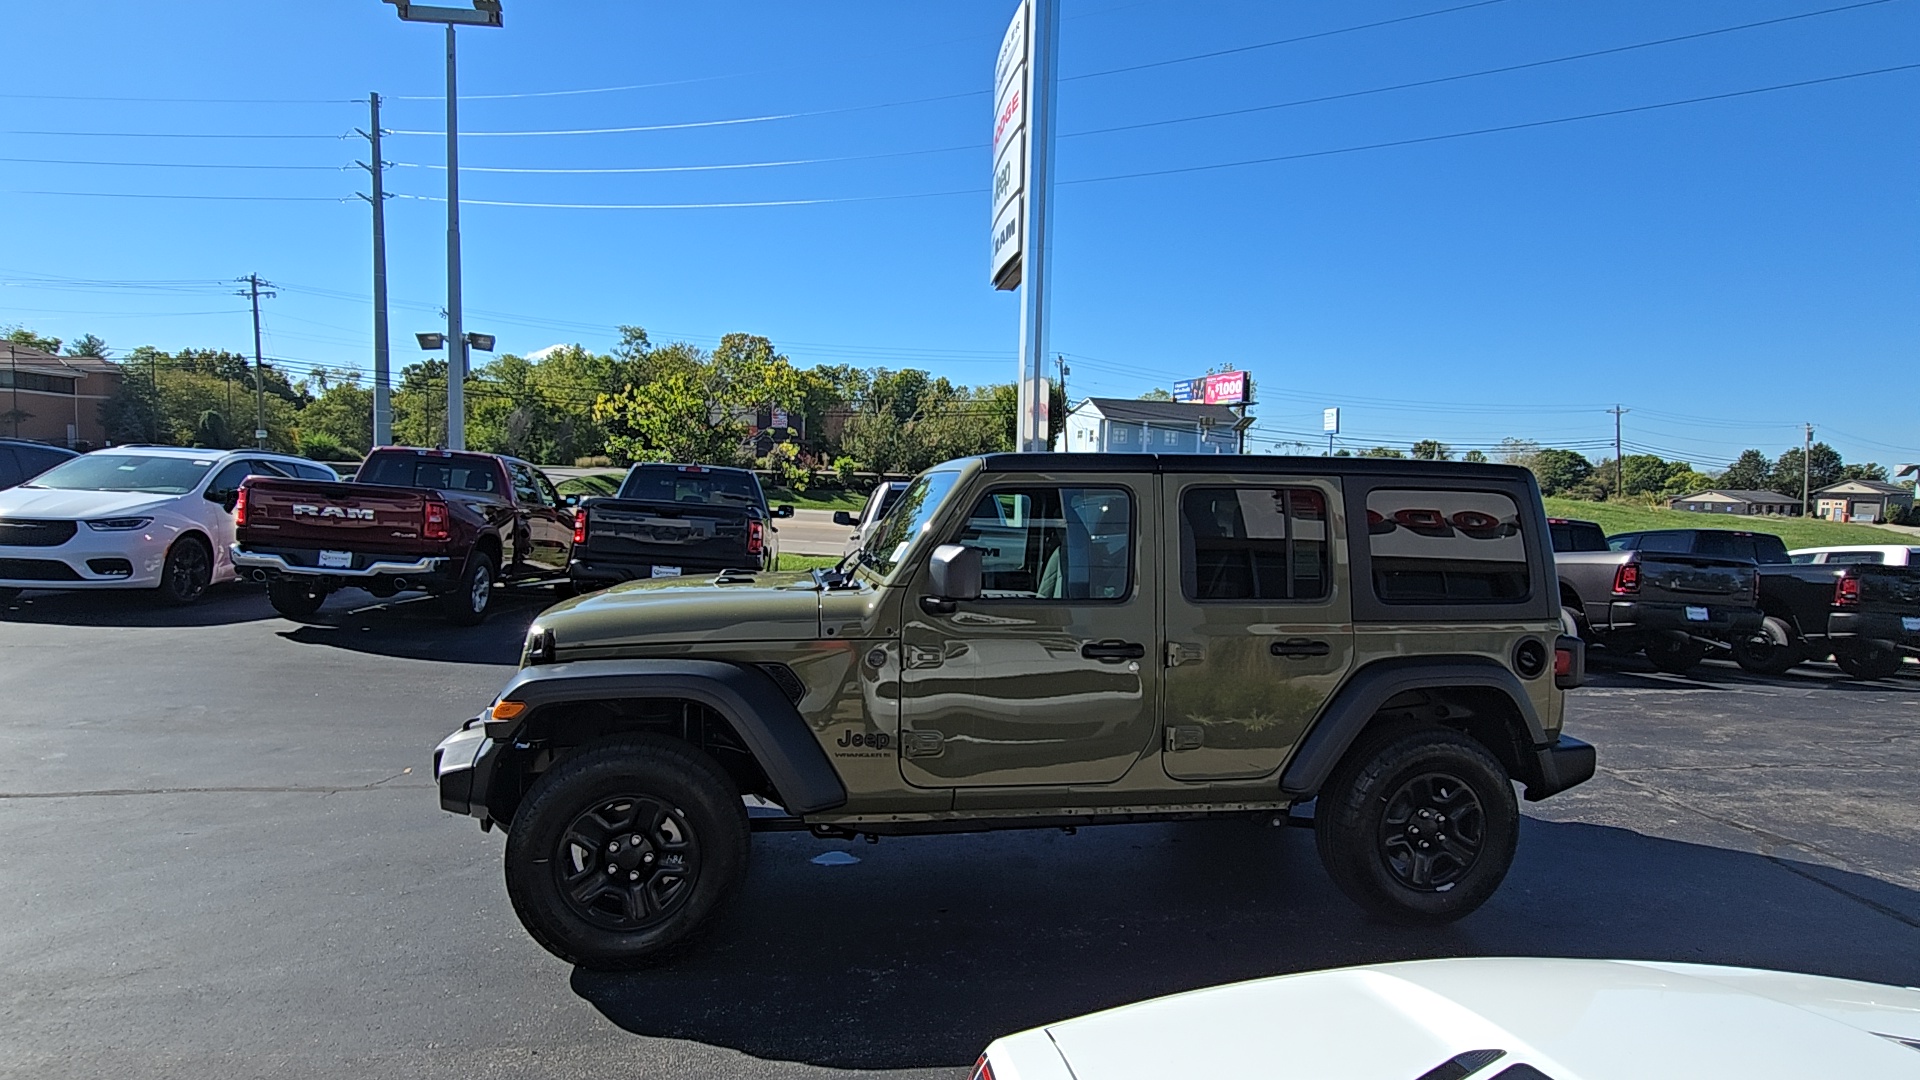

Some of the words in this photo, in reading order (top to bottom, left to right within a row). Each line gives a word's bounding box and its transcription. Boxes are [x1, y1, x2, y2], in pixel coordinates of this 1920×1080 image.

[995, 217, 1016, 256] RAM
[292, 503, 375, 520] RAM
[836, 729, 891, 750] Jeep
